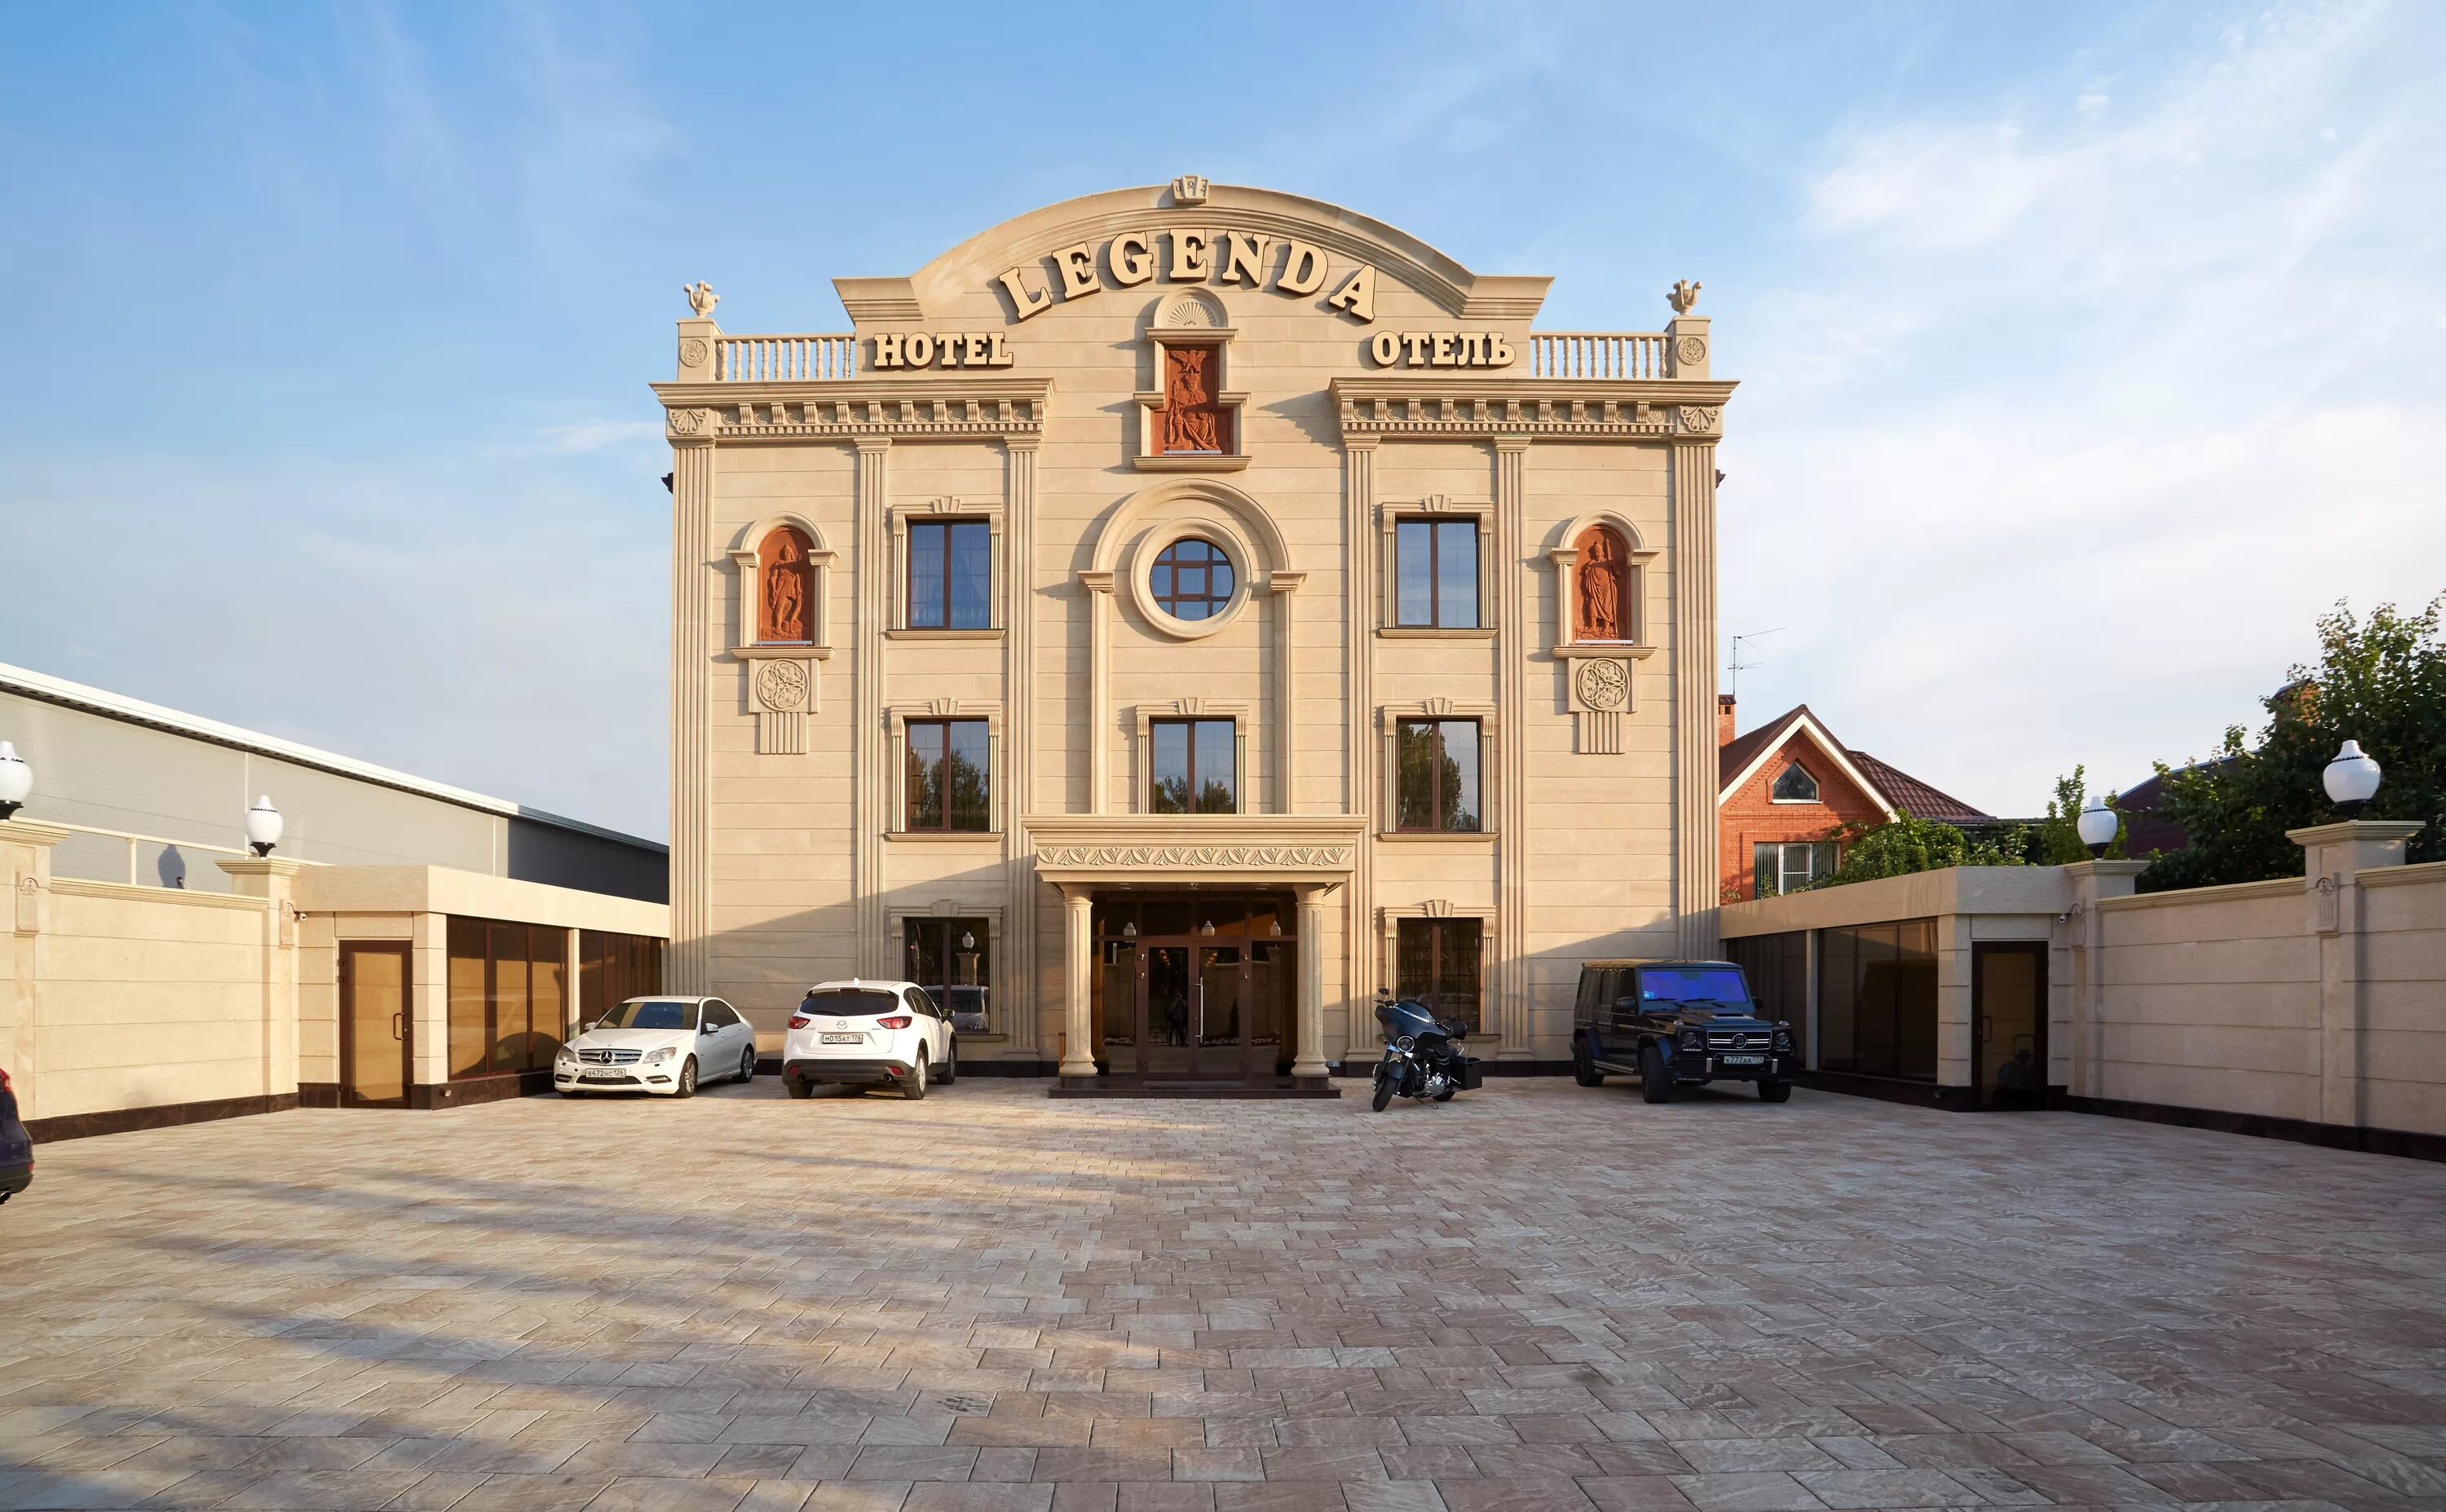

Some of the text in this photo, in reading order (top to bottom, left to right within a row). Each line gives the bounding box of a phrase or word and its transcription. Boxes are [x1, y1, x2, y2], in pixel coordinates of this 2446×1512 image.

[999, 227, 1376, 323] LEGENDA
[874, 332, 1014, 369] HOTEL
[1371, 331, 1517, 368] ОТЕЛЬ
